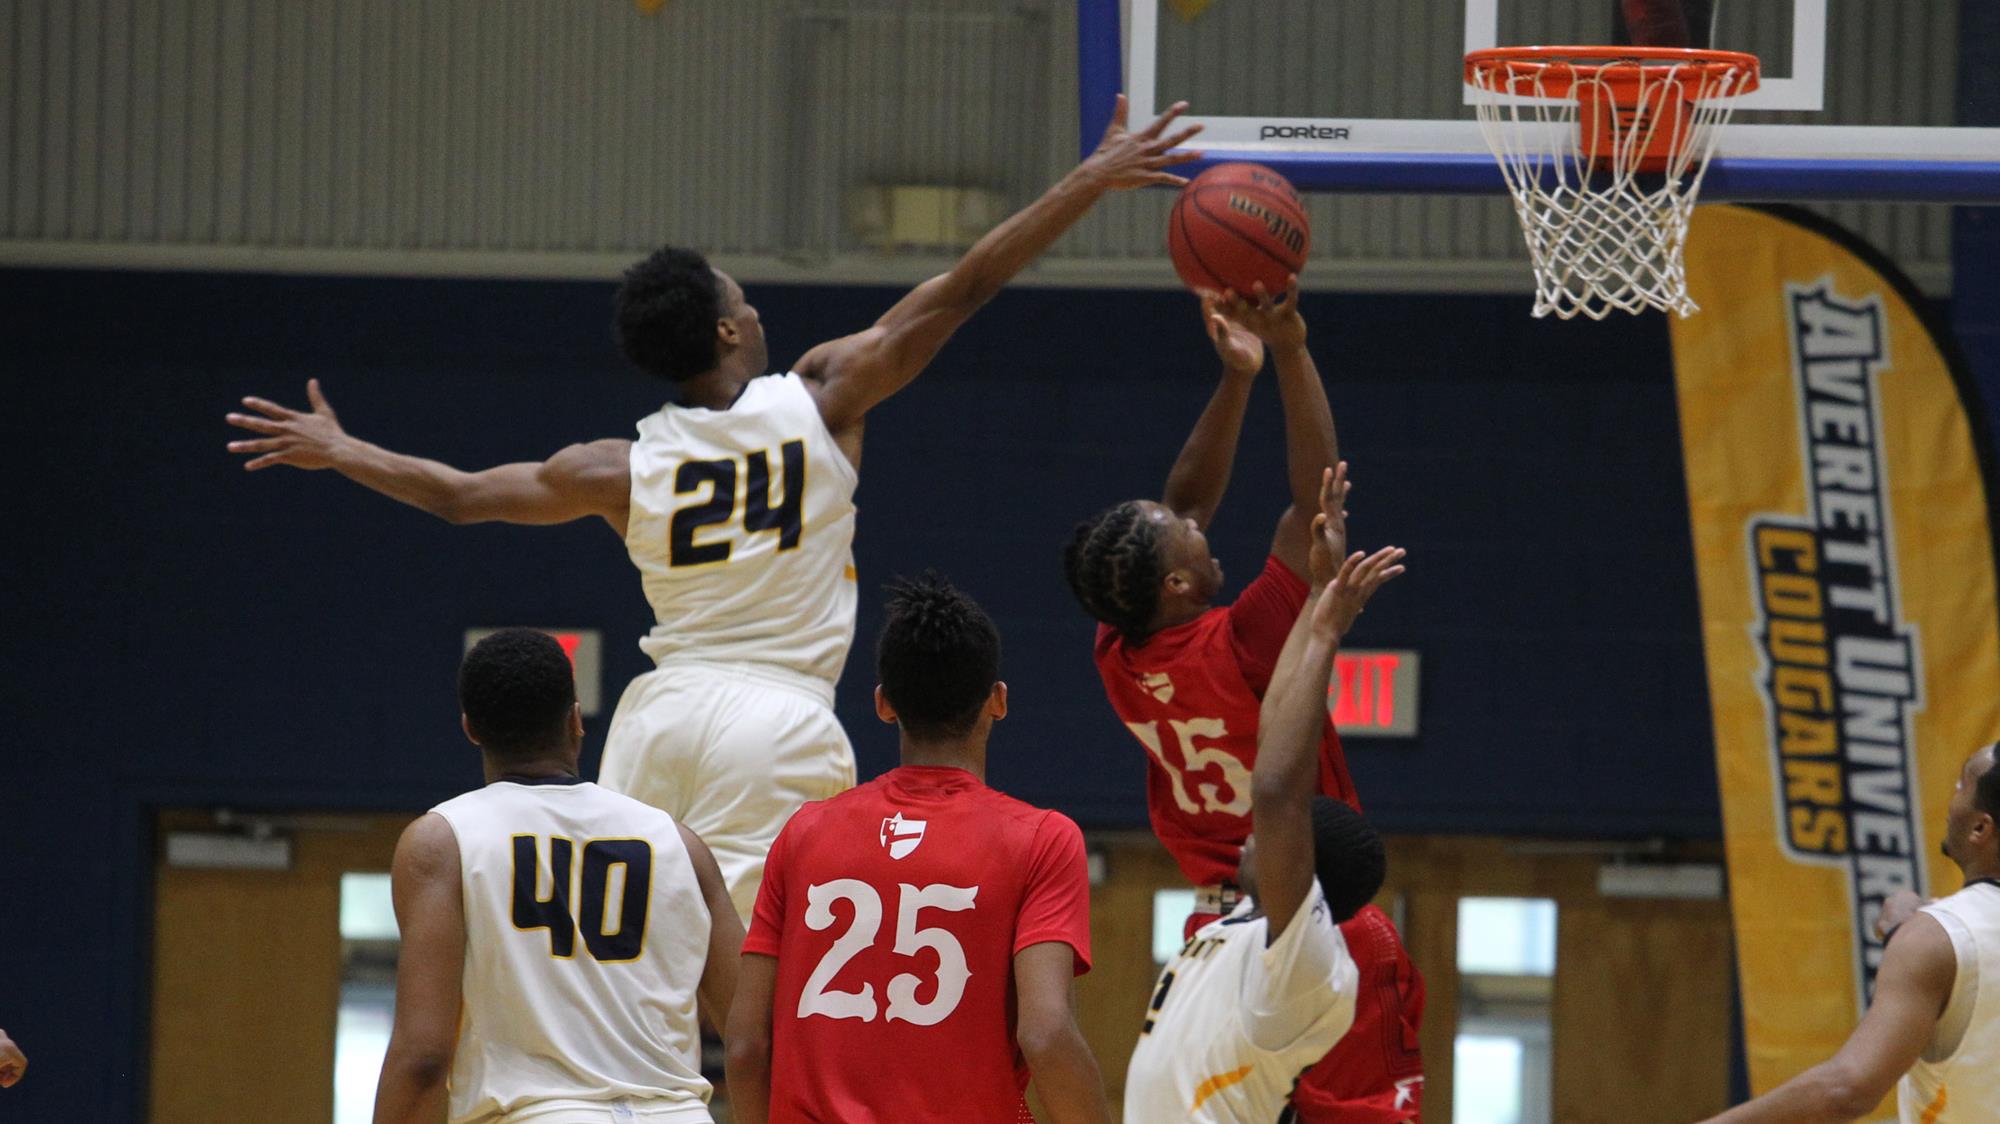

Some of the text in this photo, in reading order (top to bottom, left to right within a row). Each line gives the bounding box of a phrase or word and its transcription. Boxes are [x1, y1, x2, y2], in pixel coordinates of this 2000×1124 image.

[1228, 192, 1304, 255] Wilson
[669, 438, 806, 568] 24
[1328, 653, 1400, 728] XIT
[1758, 528, 1847, 856] COUGARS
[1795, 287, 1914, 1000] AVERETT UNIVER
[1125, 716, 1253, 818] 15
[509, 833, 654, 964] 40
[797, 878, 979, 1026] 25
